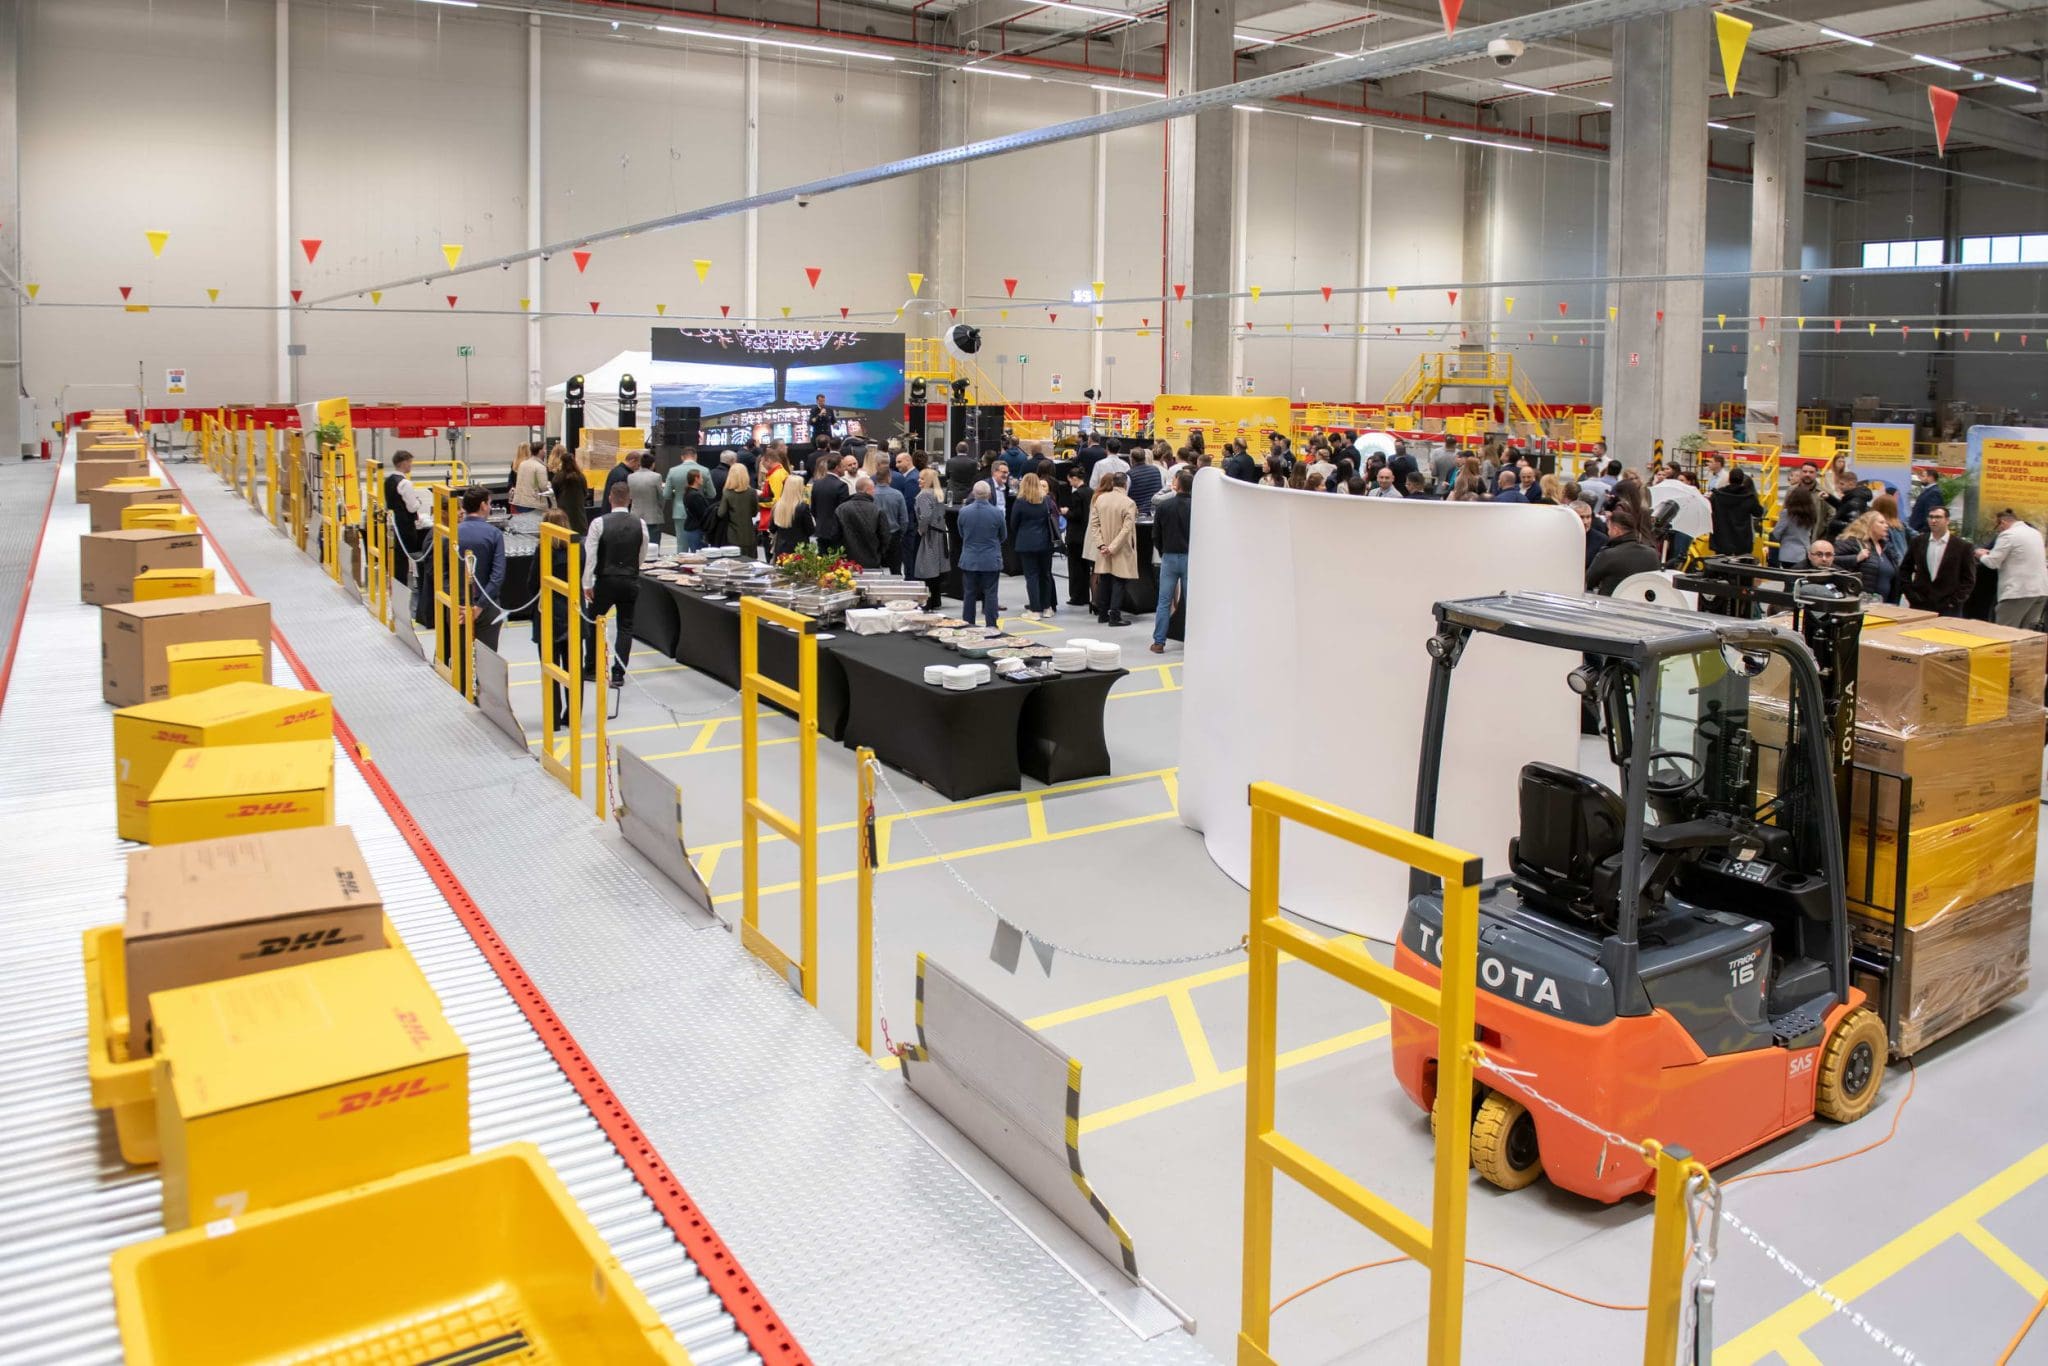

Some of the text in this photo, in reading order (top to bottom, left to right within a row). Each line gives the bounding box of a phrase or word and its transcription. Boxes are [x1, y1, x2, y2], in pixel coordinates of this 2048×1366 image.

[282, 709, 317, 726] DHL
[238, 802, 295, 817] DHL
[256, 927, 351, 957] DHL
[1419, 923, 1562, 1011] TOTA
[1731, 963, 1755, 988] 16
[1790, 1052, 1815, 1074] SAS
[333, 1076, 436, 1115] DHL
